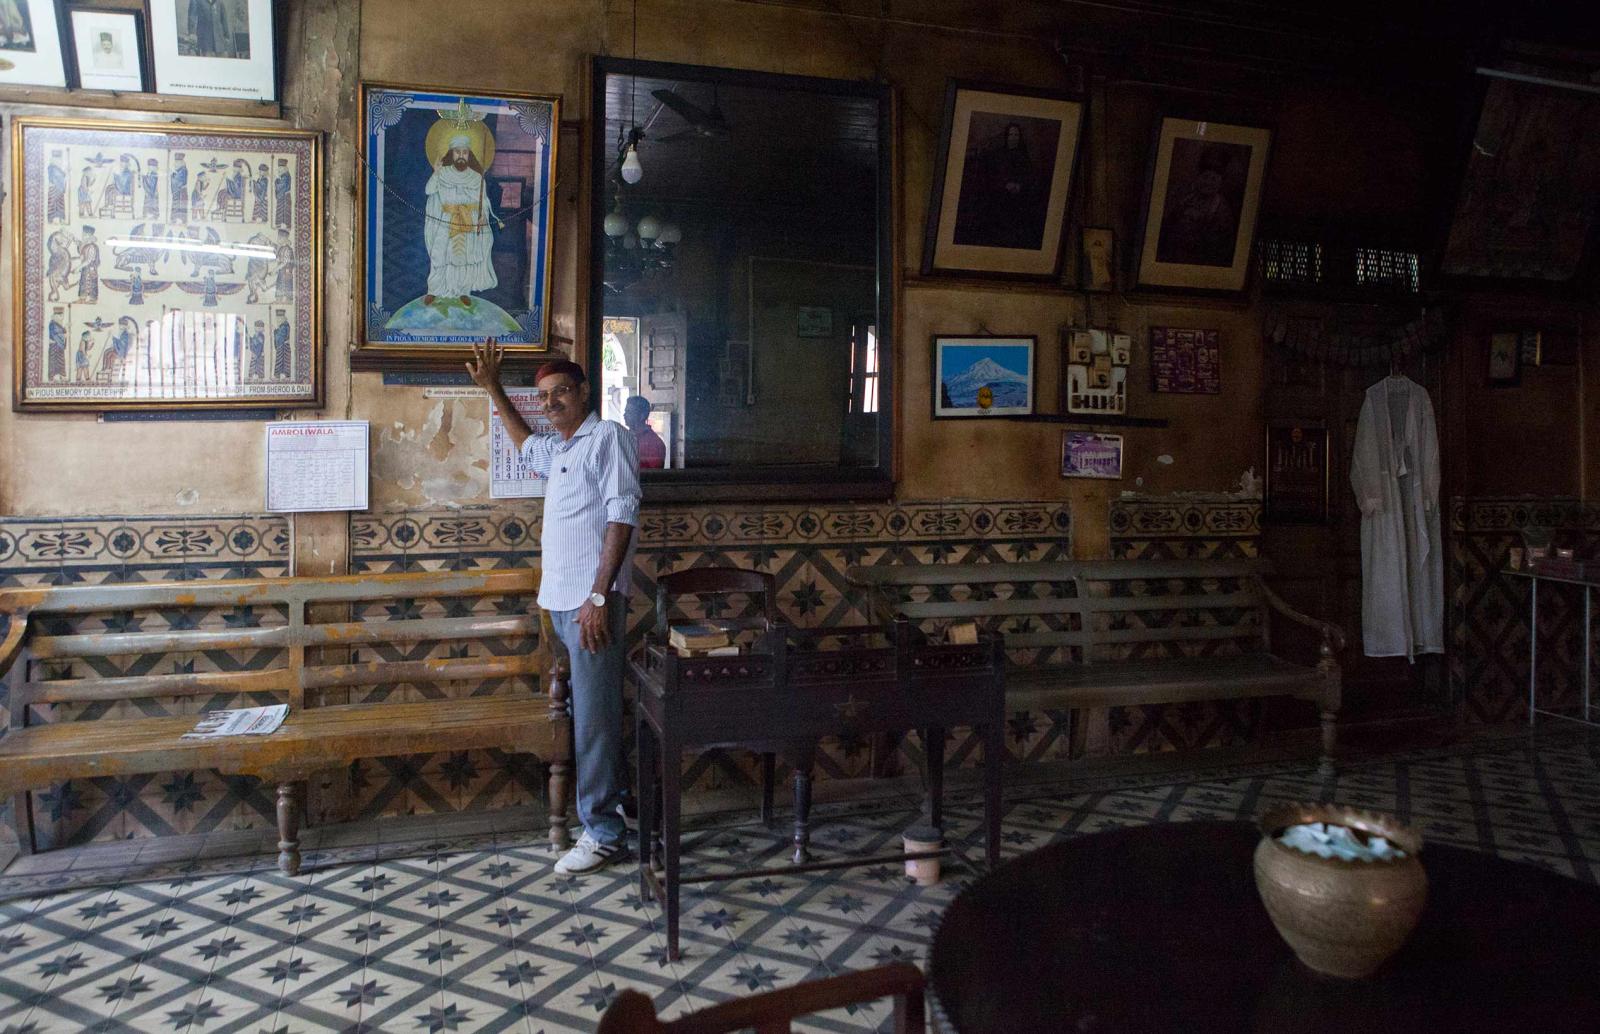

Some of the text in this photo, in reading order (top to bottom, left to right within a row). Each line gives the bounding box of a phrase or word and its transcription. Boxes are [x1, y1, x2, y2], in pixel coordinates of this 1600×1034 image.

[36, 387, 54, 397] PIOUS
[55, 387, 82, 397] MEMORY
[84, 387, 91, 396] OF
[249, 385, 266, 393] FROM
[516, 463, 526, 471] 10
[516, 472, 525, 480] 11
